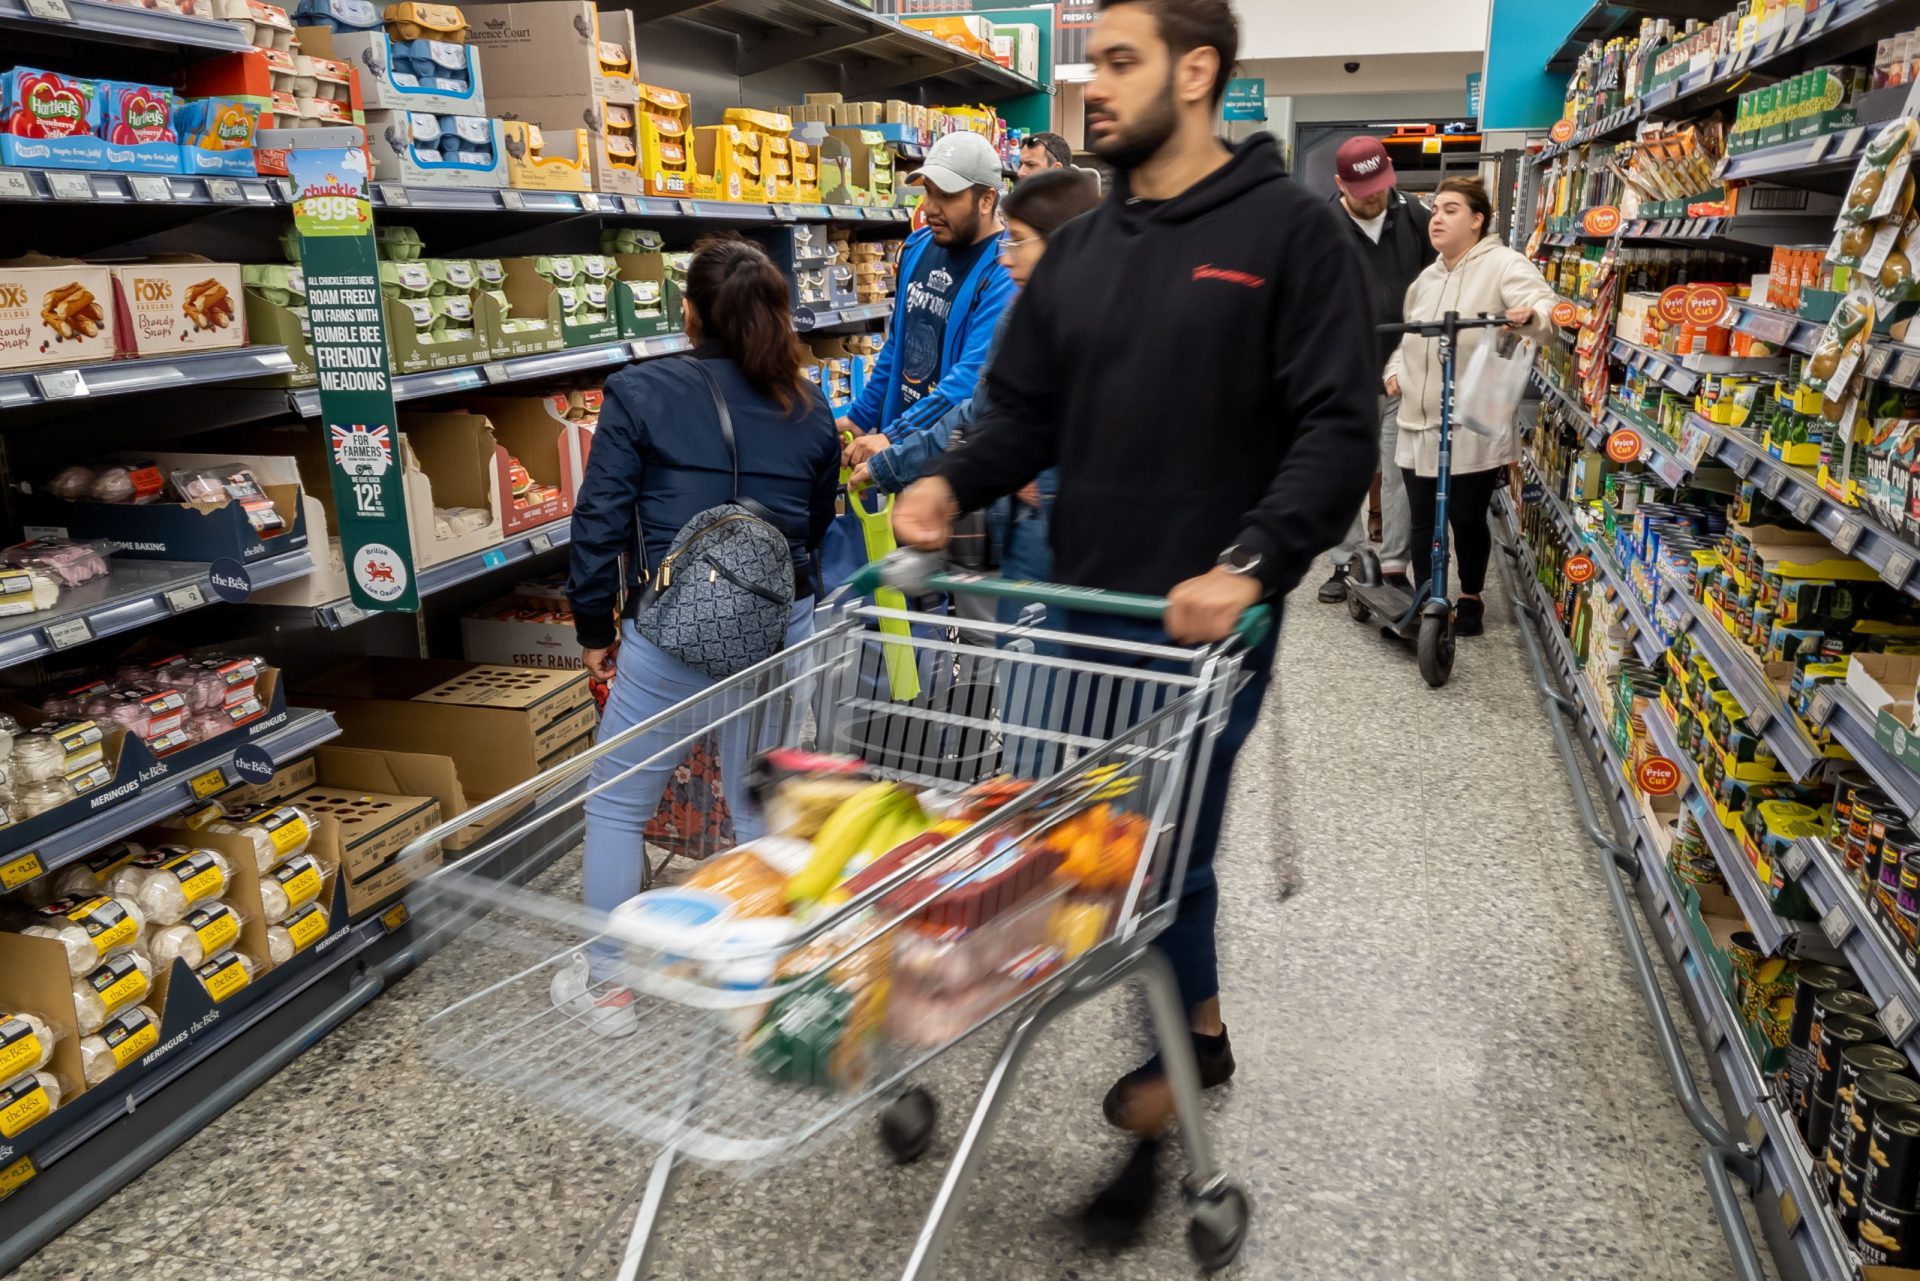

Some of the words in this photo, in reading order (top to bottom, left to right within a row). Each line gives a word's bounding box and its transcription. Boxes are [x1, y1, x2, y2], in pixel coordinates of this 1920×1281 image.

[1063, 13, 1085, 21] FRESH
[503, 28, 531, 39] Court
[32, 96, 79, 117] Hartley's
[129, 110, 164, 128] Hartley's
[219, 121, 248, 138] Hartley's
[1353, 155, 1381, 172] DKNY
[303, 183, 358, 199] chuckle
[666, 178, 685, 192] FREE
[305, 196, 358, 221] eggs
[1596, 214, 1614, 222] Price
[1598, 220, 1612, 228] Cut
[319, 276, 344, 285] CHUCKLE
[344, 276, 359, 285] EGGS
[359, 276, 374, 285] HENS
[0, 284, 28, 308] OX'S
[309, 289, 340, 305] ROAM
[340, 289, 376, 305] FREELY
[1665, 298, 1684, 308] Pric
[1691, 298, 1717, 307] Price
[136, 303, 175, 311] FABULOUS
[1670, 307, 1683, 315] Cu
[1694, 306, 1714, 316] Cut
[138, 313, 175, 330] Brandy
[311, 309, 325, 322] ON
[325, 309, 356, 322] FARMS
[356, 308, 379, 322] WITH
[143, 327, 172, 340] Snaps
[314, 326, 359, 343] BUMBLE
[359, 326, 382, 342] BEE
[316, 347, 382, 368] FRIENDLY
[320, 371, 386, 391] MEADOWS
[353, 434, 369, 446] FOR
[1613, 439, 1634, 448] Price
[343, 445, 382, 457] FARMERS
[1616, 445, 1632, 454] Cut
[134, 542, 165, 551] BAKING
[365, 547, 388, 556] British
[1570, 563, 1588, 571] Price
[211, 574, 228, 586] the
[228, 577, 249, 591] Best
[364, 583, 378, 595] Lion
[379, 584, 402, 597] Quality
[249, 711, 287, 736] MERINGUES
[138, 771, 151, 783] he
[150, 764, 169, 778] Best
[235, 758, 251, 770] the
[251, 763, 272, 775] Best
[1646, 769, 1672, 778] Price
[1649, 777, 1667, 785] Cut
[91, 779, 140, 809] MERINGUES
[287, 825, 301, 836] Best
[199, 874, 216, 887] Best
[300, 874, 314, 887] Best
[215, 921, 230, 935] Best
[306, 918, 320, 931] Best
[103, 933, 116, 945] the
[115, 924, 132, 937] Best
[315, 925, 350, 953] MERINGUES
[213, 978, 225, 988] the
[224, 969, 240, 982] Best
[110, 990, 123, 1001] the
[122, 978, 139, 993] Best
[143, 1030, 189, 1067] MERINGUES
[190, 1021, 203, 1034] the
[202, 1009, 220, 1024] Best
[122, 1046, 136, 1058] the
[135, 1033, 152, 1048] Best
[0, 1054, 11, 1065] he
[11, 1042, 32, 1057] Best
[6, 1109, 22, 1123] the
[20, 1097, 41, 1113] Best
[0, 1145, 13, 1160] est
[1858, 1239, 1887, 1263] BUTTER
